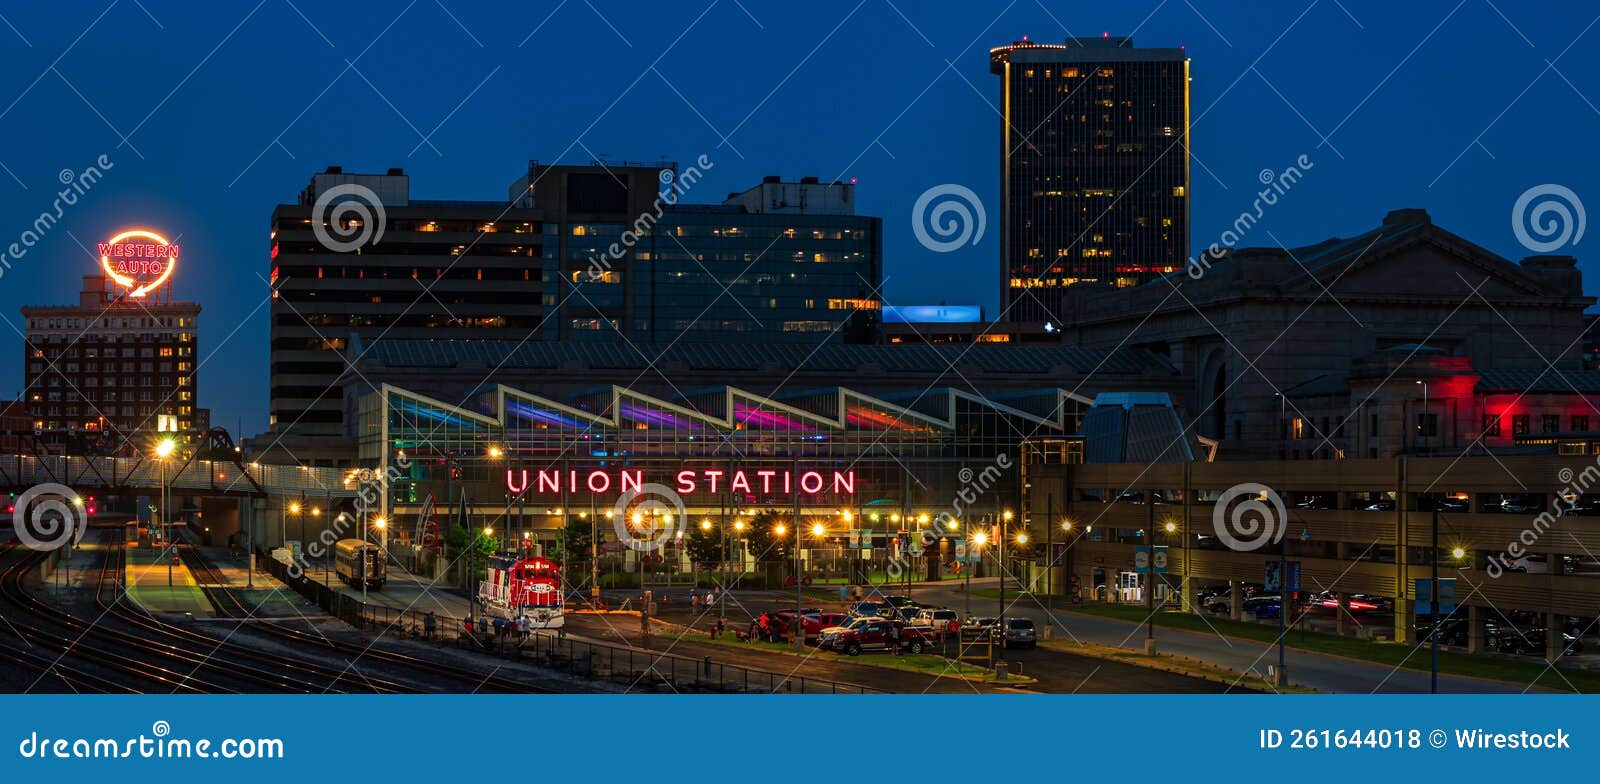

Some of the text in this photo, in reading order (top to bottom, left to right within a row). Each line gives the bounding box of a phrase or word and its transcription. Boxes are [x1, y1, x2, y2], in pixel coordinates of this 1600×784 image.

[98, 243, 179, 258] WESTERN
[116, 260, 162, 274] AUTO
[506, 469, 855, 495] UNION STATION
